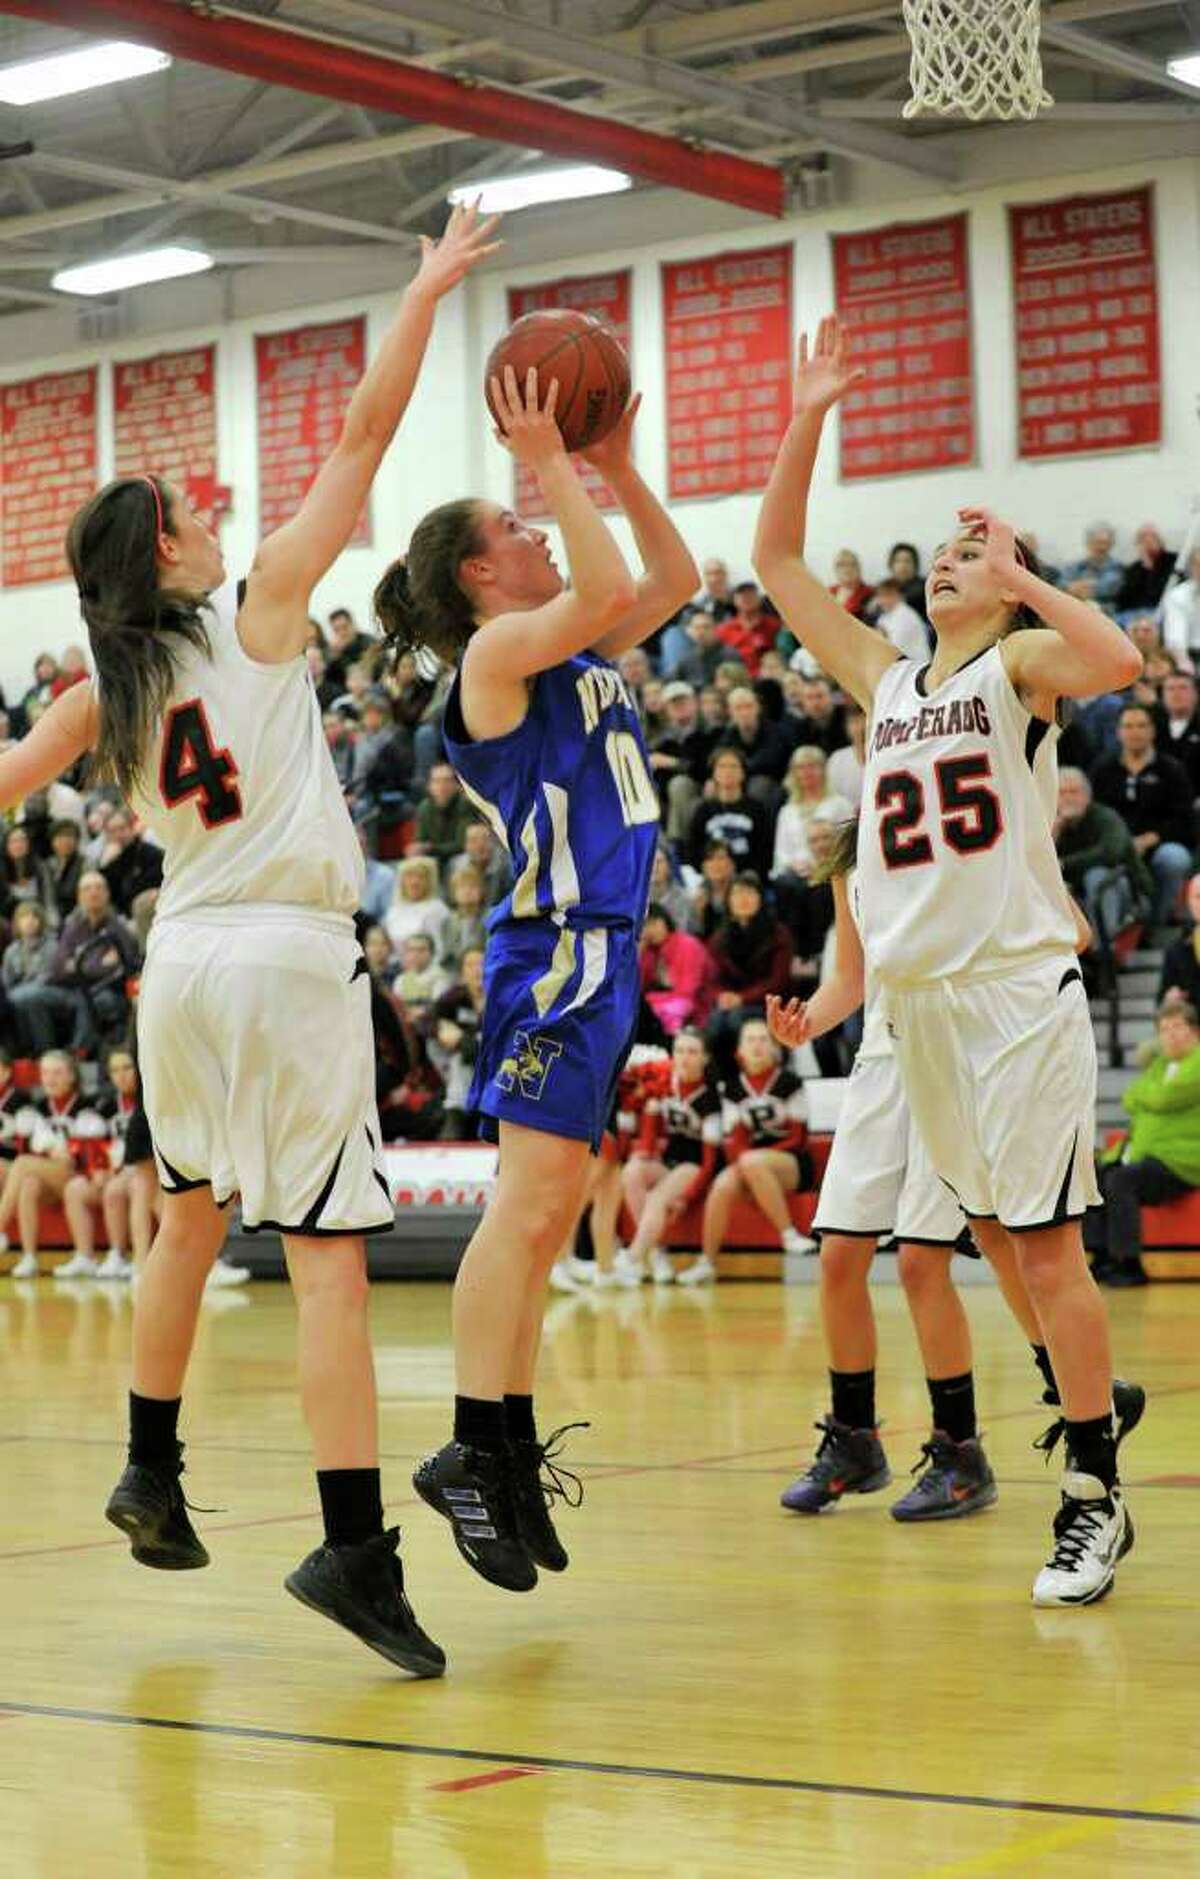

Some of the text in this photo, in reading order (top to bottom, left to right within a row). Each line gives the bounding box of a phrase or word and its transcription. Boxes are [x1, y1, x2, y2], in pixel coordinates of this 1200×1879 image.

[158, 697, 243, 831] 4
[869, 696, 991, 758] OMPERAUG
[874, 750, 1005, 873] 25
